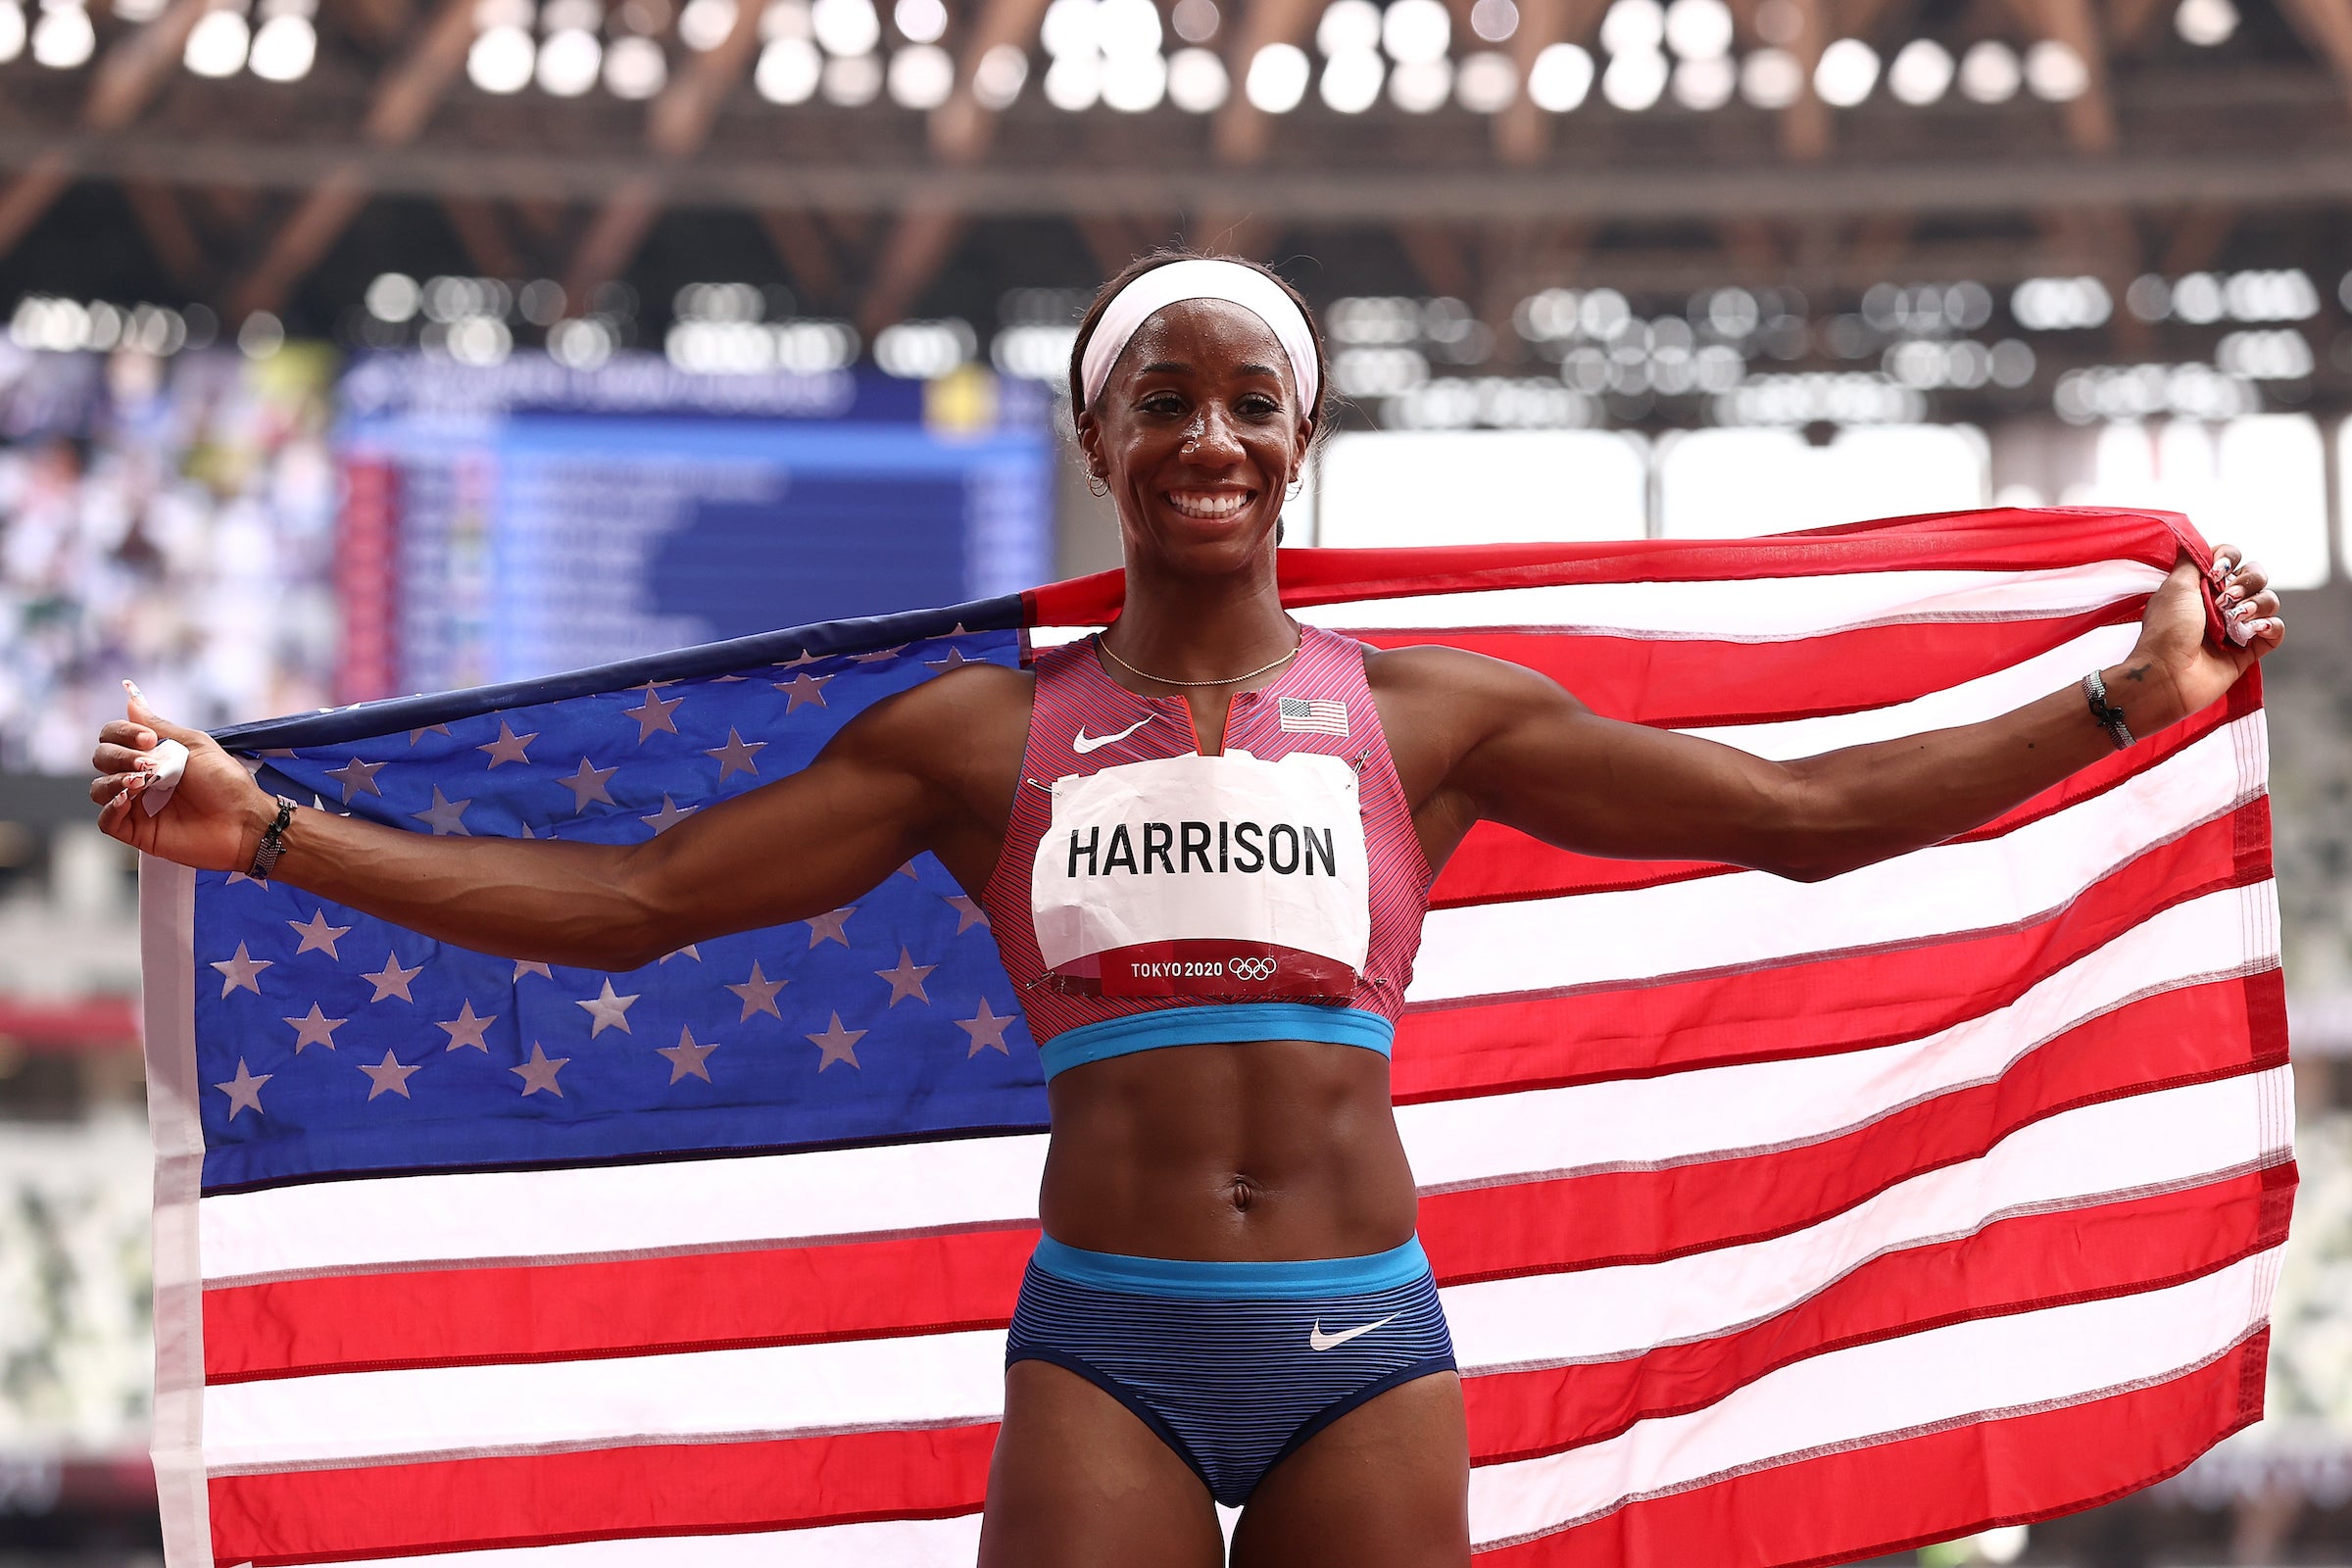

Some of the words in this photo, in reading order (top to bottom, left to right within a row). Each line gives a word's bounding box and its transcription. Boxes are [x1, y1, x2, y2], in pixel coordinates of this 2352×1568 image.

[1067, 821, 1336, 877] HARRISON
[1131, 961, 1181, 978] TOKYO
[1184, 961, 1223, 977] 2020
